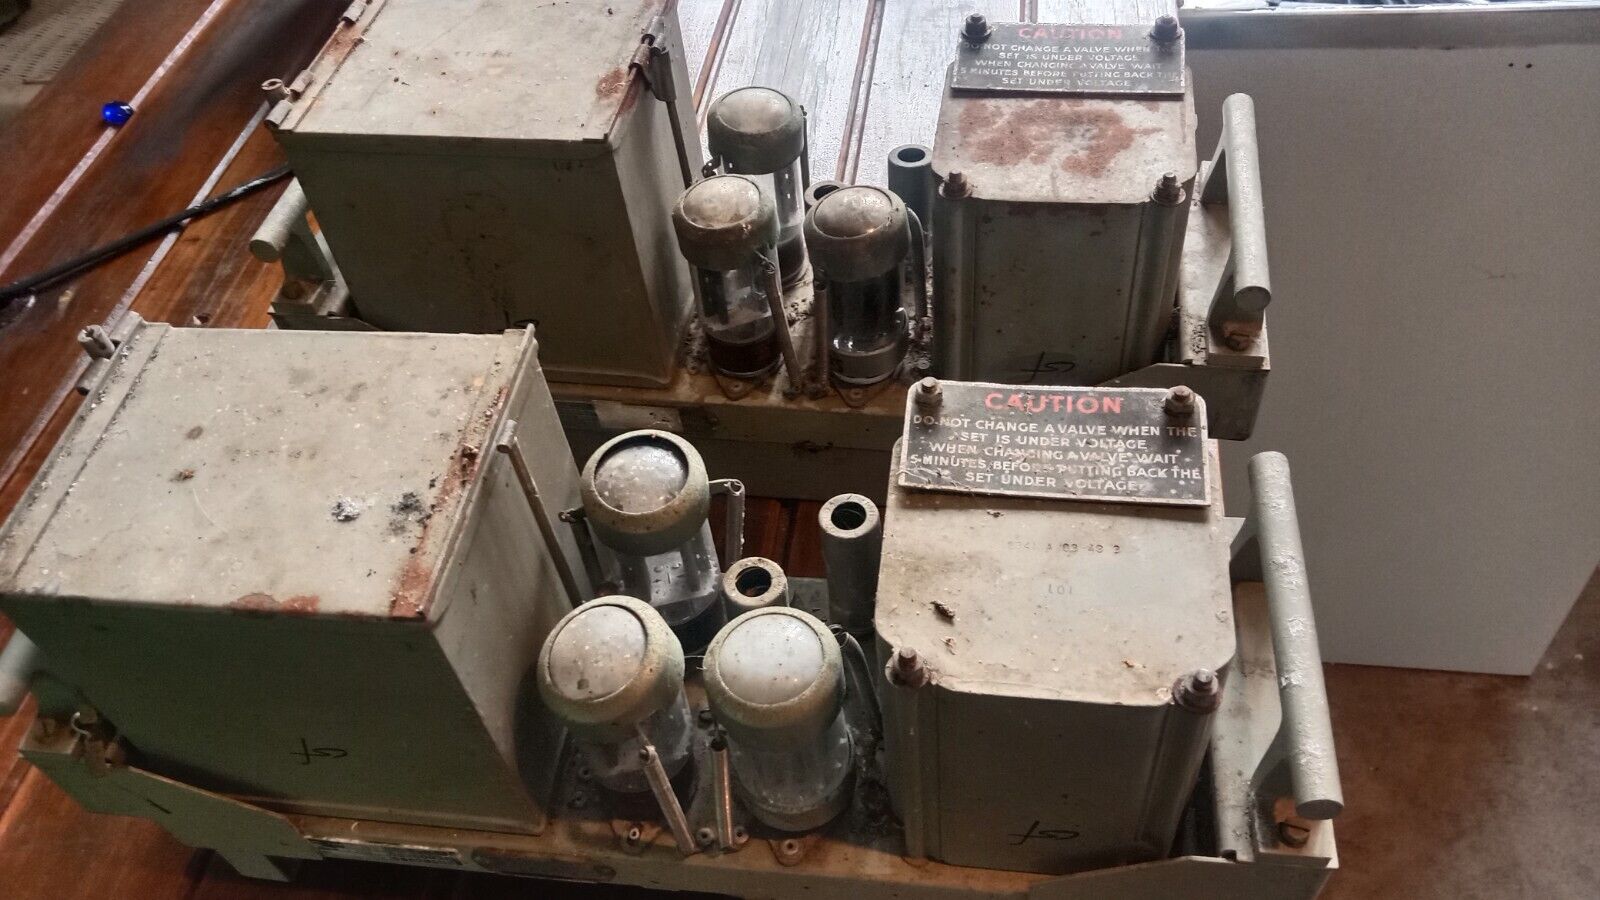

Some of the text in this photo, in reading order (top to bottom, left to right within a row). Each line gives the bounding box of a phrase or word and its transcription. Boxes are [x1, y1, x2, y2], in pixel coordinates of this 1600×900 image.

[1019, 27, 1121, 40] CAUTION
[983, 43, 1007, 51] NOT
[1011, 44, 1060, 53] CHANGE
[999, 52, 1020, 60] SET
[1042, 53, 1082, 61] UNDER
[1017, 61, 1073, 69] CHANGING
[970, 68, 1018, 76] MINUTES
[1023, 70, 1067, 78] BEFORE
[1002, 77, 1023, 85] SET
[984, 391, 1123, 414] CAUTION
[913, 414, 1197, 438] DO NOT CHANGE A VALVE WHEN THE
[960, 432, 1148, 450] SET IS UNDER VOLTAGE
[930, 441, 1179, 464] WHEN CHANGING A VALVE WAIT
[923, 455, 987, 470] MINUTES
[1126, 466, 1169, 479] BACK
[1172, 467, 1202, 480] THE
[965, 471, 1139, 491] SET UNDER VOLTAGE
